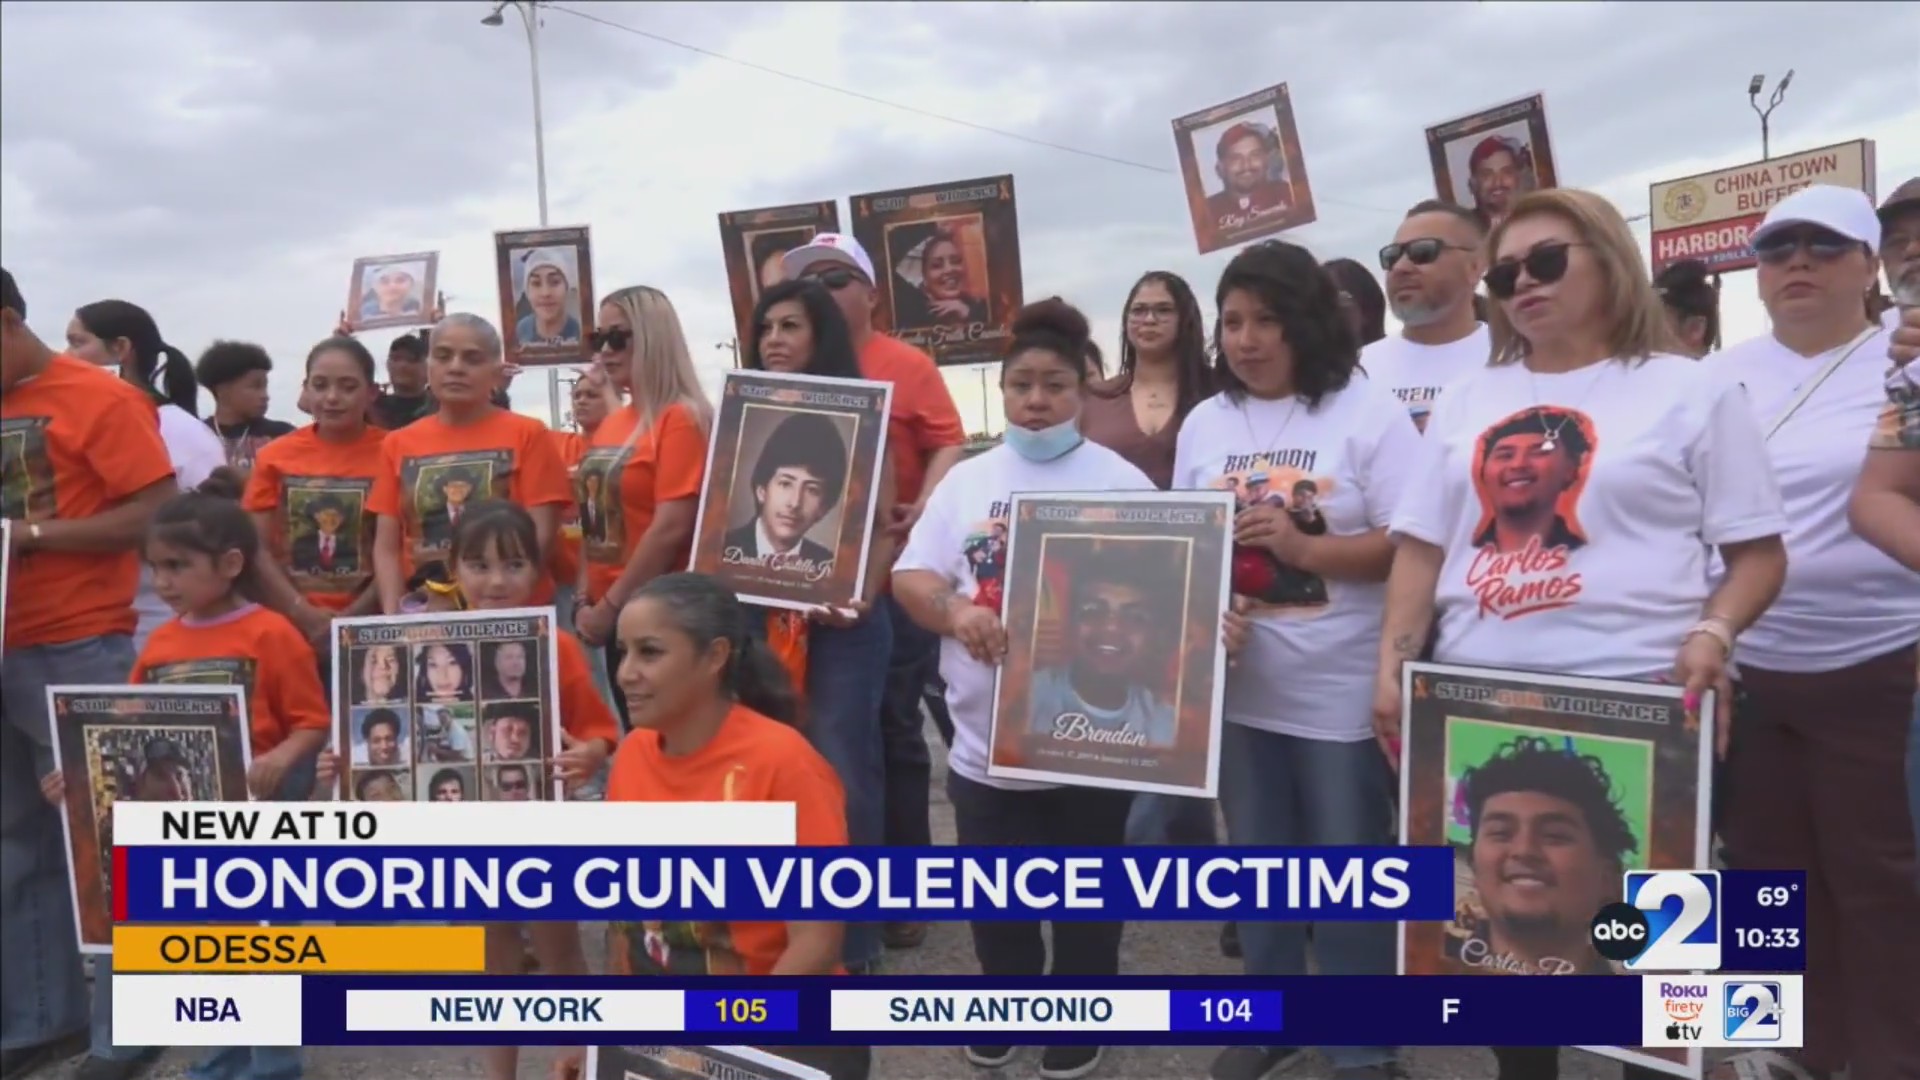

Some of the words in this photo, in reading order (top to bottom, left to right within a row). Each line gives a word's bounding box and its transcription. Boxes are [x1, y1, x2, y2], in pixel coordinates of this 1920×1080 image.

[1714, 169, 1772, 195] CHINA
[1777, 154, 1838, 180] TOWN
[1658, 225, 1751, 260] HARBOR
[1224, 448, 1318, 475] BRENDON
[1467, 534, 1569, 586] Carlos
[1474, 573, 1582, 619] Ramos
[359, 627, 402, 643] STOP
[443, 622, 529, 639] VIOLENCE
[1435, 681, 1493, 702] STOP
[1545, 694, 1670, 724] VIOLENCE
[1053, 712, 1147, 747] Brendon
